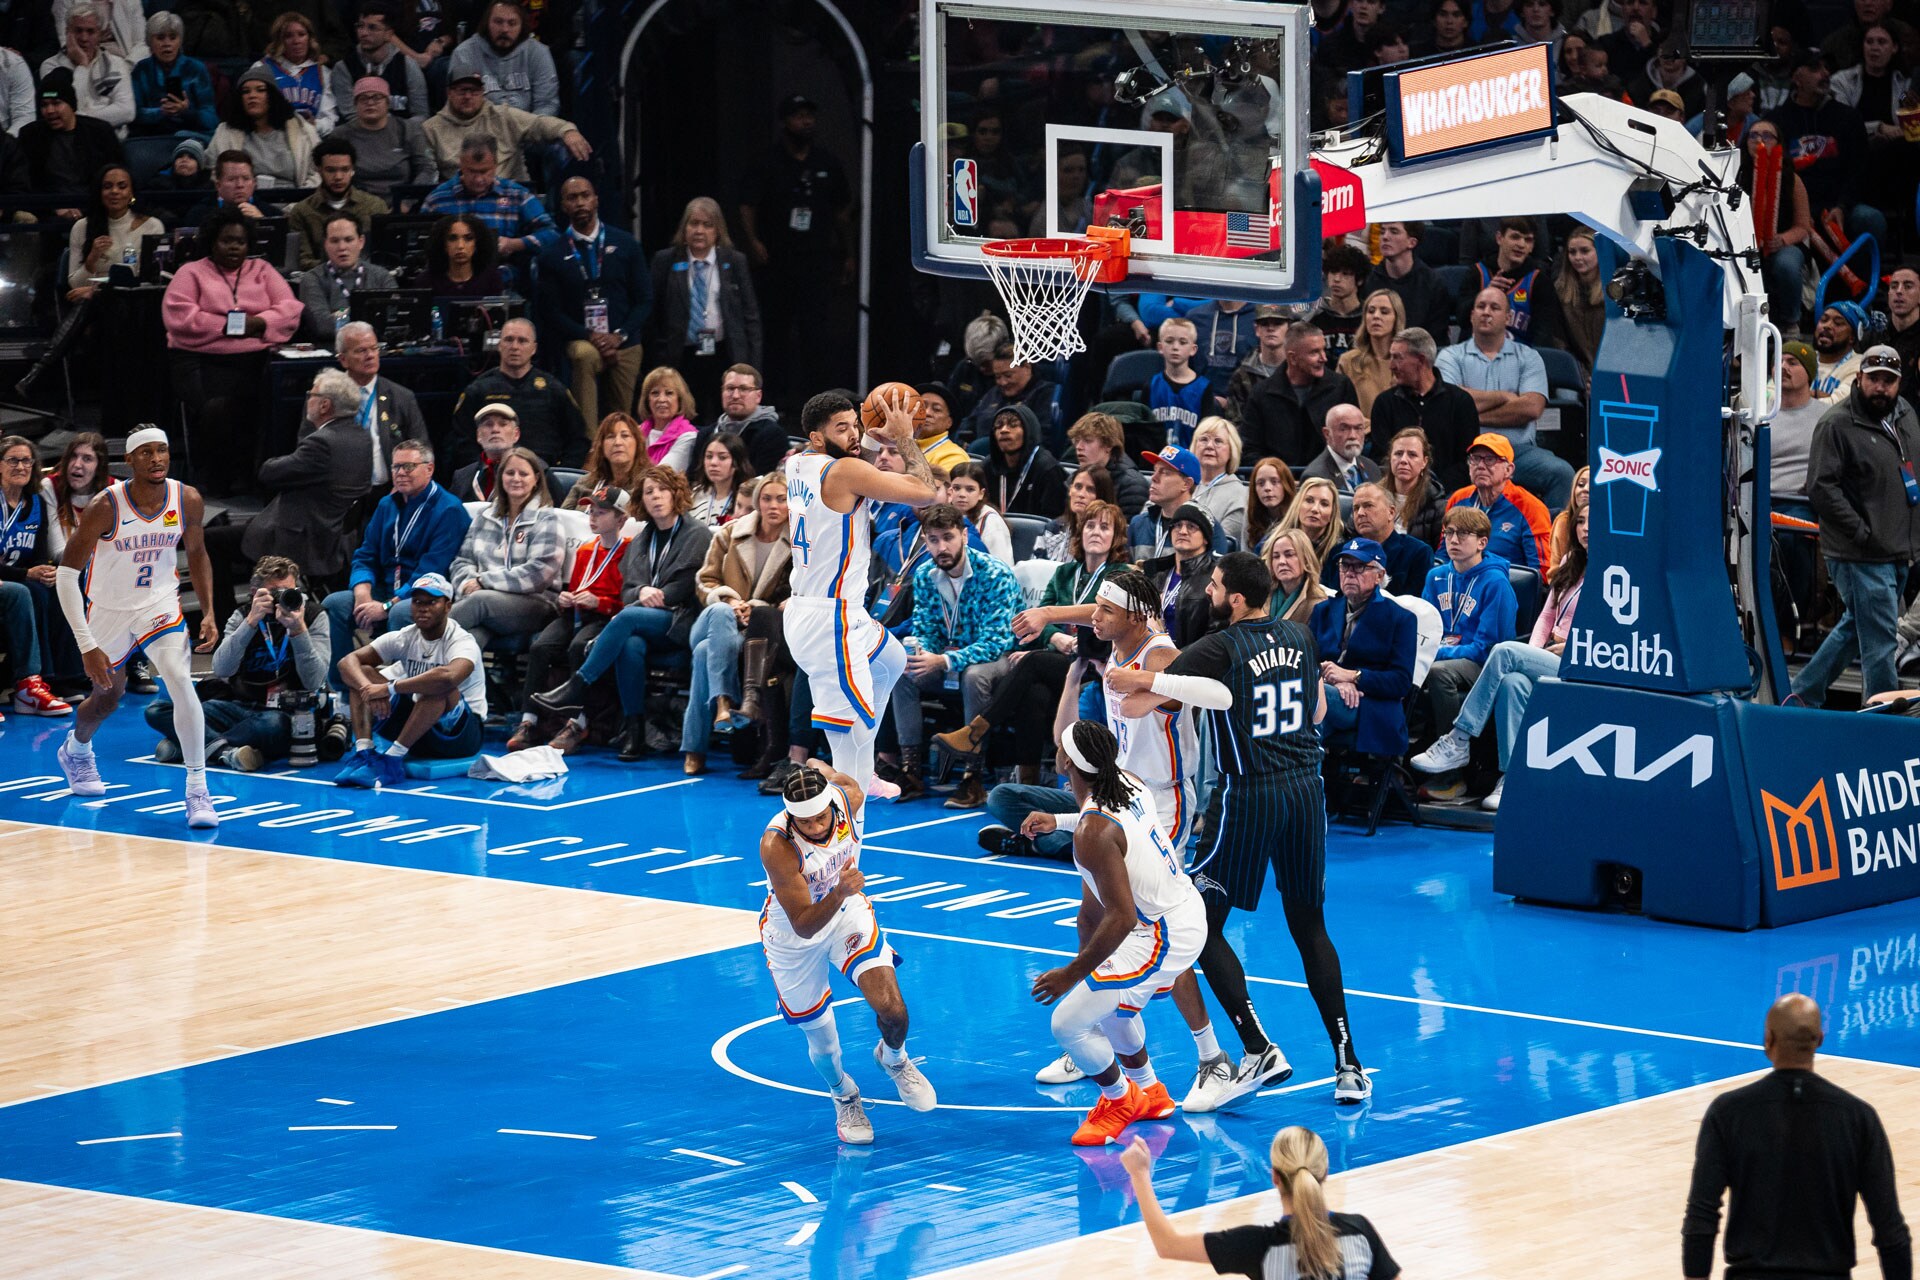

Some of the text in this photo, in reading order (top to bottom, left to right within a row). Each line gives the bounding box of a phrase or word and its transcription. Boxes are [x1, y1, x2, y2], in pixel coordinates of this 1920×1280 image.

[1403, 68, 1545, 137] WHATABURGER
[957, 209, 969, 221] NBA
[1322, 184, 1354, 214] arm
[1603, 458, 1651, 477] SONIC
[132, 548, 164, 564] CITY
[134, 563, 154, 589] 2
[1602, 564, 1641, 626] OU
[1248, 646, 1303, 677] BITADZE
[1570, 627, 1675, 677] Health
[1251, 677, 1304, 739] 35
[1526, 716, 1714, 788] KIA
[487, 836, 743, 875] CITY
[1149, 825, 1178, 878] 5
[1847, 823, 1920, 876] BAN
